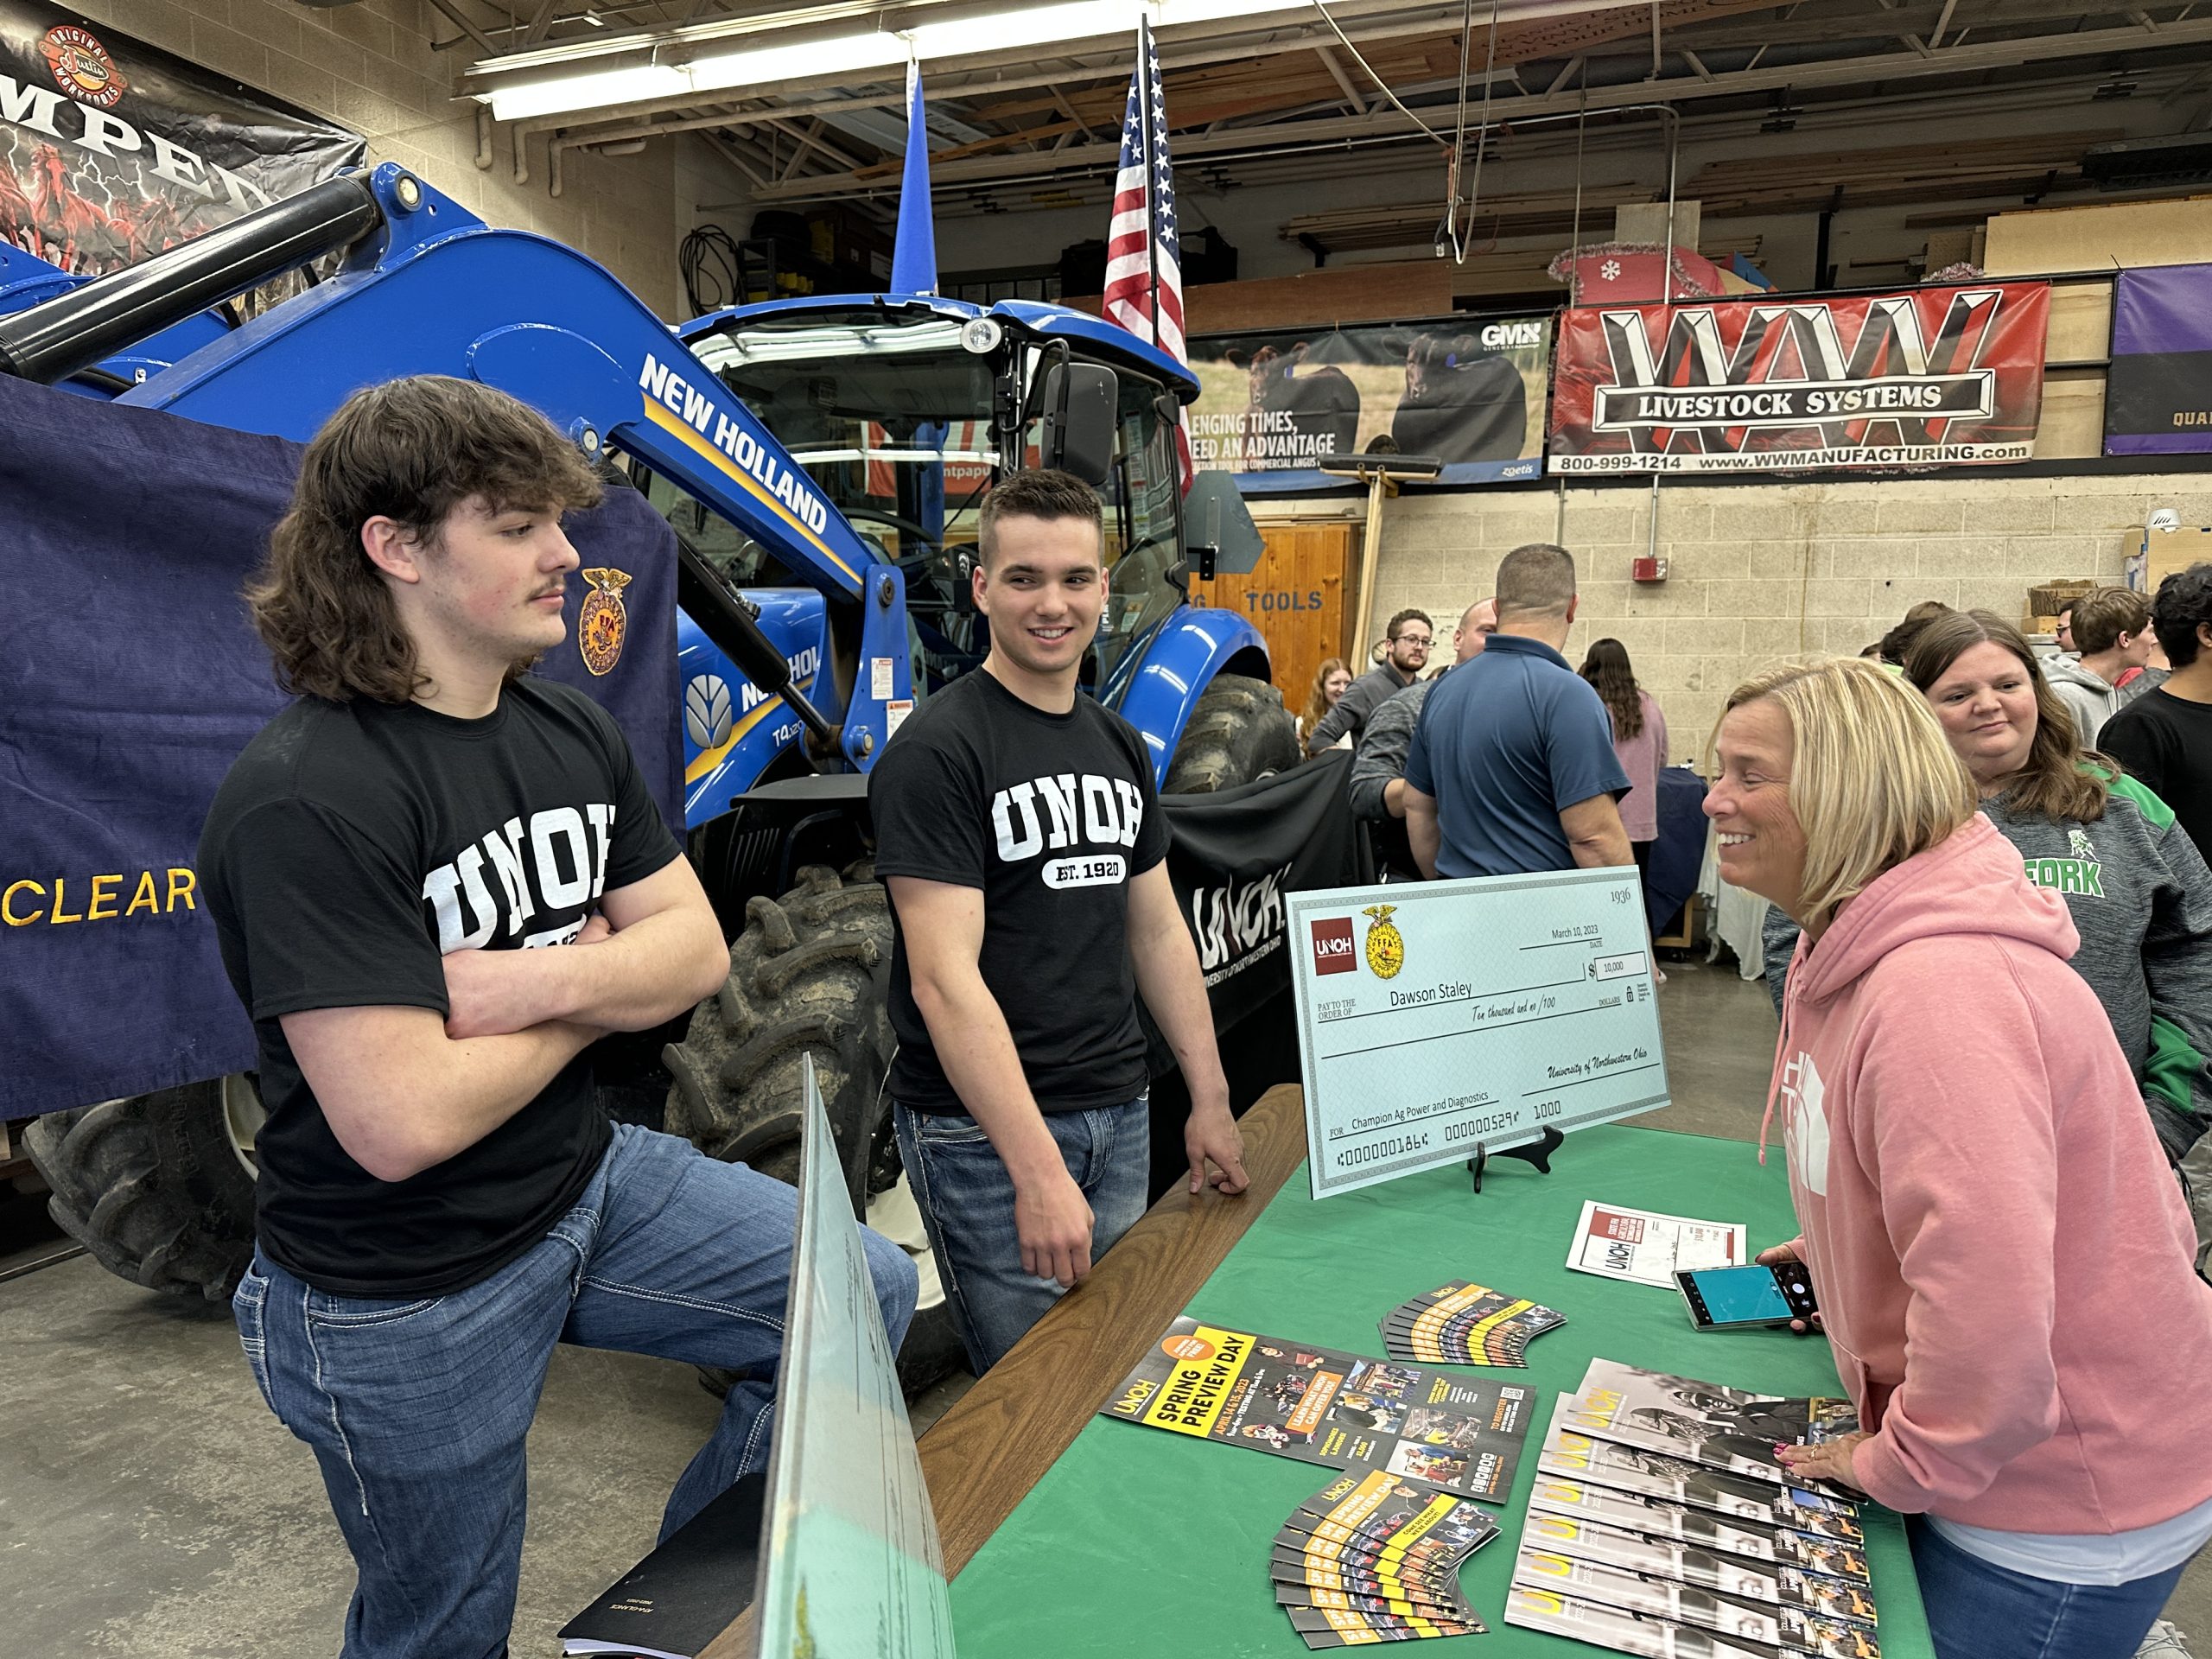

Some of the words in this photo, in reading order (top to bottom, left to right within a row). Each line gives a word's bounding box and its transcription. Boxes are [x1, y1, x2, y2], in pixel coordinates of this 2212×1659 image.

[50, 29, 109, 63] ORIGINAL
[60, 45, 105, 78] Justin
[55, 67, 118, 105] WORKBOOTS
[1481, 323, 1541, 346] GMX
[1638, 391, 1793, 419] LIVESTOCK
[1806, 385, 1942, 415] SYSTEMS
[1250, 410, 1298, 435] TIMES,
[639, 353, 715, 433] NEW
[713, 412, 827, 535] HOLLAND
[1222, 437, 1243, 458] AN
[1246, 433, 1336, 458] ADVANTAGE
[1249, 458, 1292, 470] COMMERCIAL
[1502, 463, 1534, 477] zoetis
[1560, 455, 1681, 470] 800-999-1214
[1699, 446, 2027, 469] www.WWMANUFACTURING.com
[1245, 591, 1323, 612] TOOLS
[991, 772, 1144, 862] UNOH
[1055, 865, 1079, 881] EST.
[1083, 861, 1119, 879] 1920
[2, 868, 196, 927] CLEAR
[1610, 887, 1631, 905] 1936
[1377, 938, 1393, 948] FFA
[1552, 928, 1573, 939] March
[1573, 927, 1583, 938] 10,
[1584, 925, 1599, 936] 2023
[1316, 937, 1352, 956] UNOH
[1589, 940, 1604, 949] DATE
[1588, 963, 1596, 979] $
[1604, 961, 1624, 973] 10,000
[1318, 1001, 1332, 1012] PAY
[1332, 1001, 1341, 1009] TO
[1342, 998, 1356, 1007] THE
[1389, 989, 1436, 1007] Dawson
[1439, 981, 1471, 999] Staley
[1599, 996, 1621, 1006] DOLLARS
[1318, 1011, 1343, 1020] ORDER
[1472, 1005, 1484, 1021] Ten
[1488, 1001, 1515, 1019] thousand
[1517, 998, 1528, 1013] and
[1536, 994, 1556, 1015] /100
[1548, 1063, 1582, 1078] University
[1585, 1059, 1591, 1074] of
[1592, 1054, 1631, 1069] Northwestern
[1633, 1046, 1648, 1060] Ohio
[1329, 1127, 1344, 1137] FOR
[1351, 1113, 1393, 1131] Champion
[1394, 1109, 1406, 1122] Ag
[1407, 1104, 1429, 1117] Power
[1432, 1098, 1446, 1111] and
[1448, 1091, 1489, 1109] Diagnostics
[1533, 1100, 1561, 1121] 1000
[1605, 1242, 1631, 1270] UNOH
[1181, 1363, 1230, 1427] PREVIEW
[1217, 1336, 1244, 1363] DAY
[1235, 1378, 1250, 1395] 2023
[1113, 1378, 1157, 1414] UNOH
[1156, 1370, 1201, 1422] SPRING
[1230, 1394, 1245, 1403] 15,
[1237, 1394, 1253, 1414] TESTING
[1311, 1395, 1328, 1413] OFFER
[1223, 1407, 1236, 1415] 14
[1291, 1408, 1308, 1427] LEARN
[1301, 1392, 1318, 1410] WHAT
[1305, 1411, 1319, 1425] CAN
[1493, 1398, 1507, 1422] REGISTER
[1215, 1414, 1232, 1435] APRIL
[1552, 1433, 1591, 1468] UNO
[1321, 1478, 1357, 1501] UNOH
[1344, 1491, 1383, 1524] PREVIEW
[1379, 1477, 1396, 1493] DAY
[1332, 1494, 1366, 1521] SPRING
[1402, 1523, 1417, 1535] COME
[1423, 1507, 1435, 1519] WHAT
